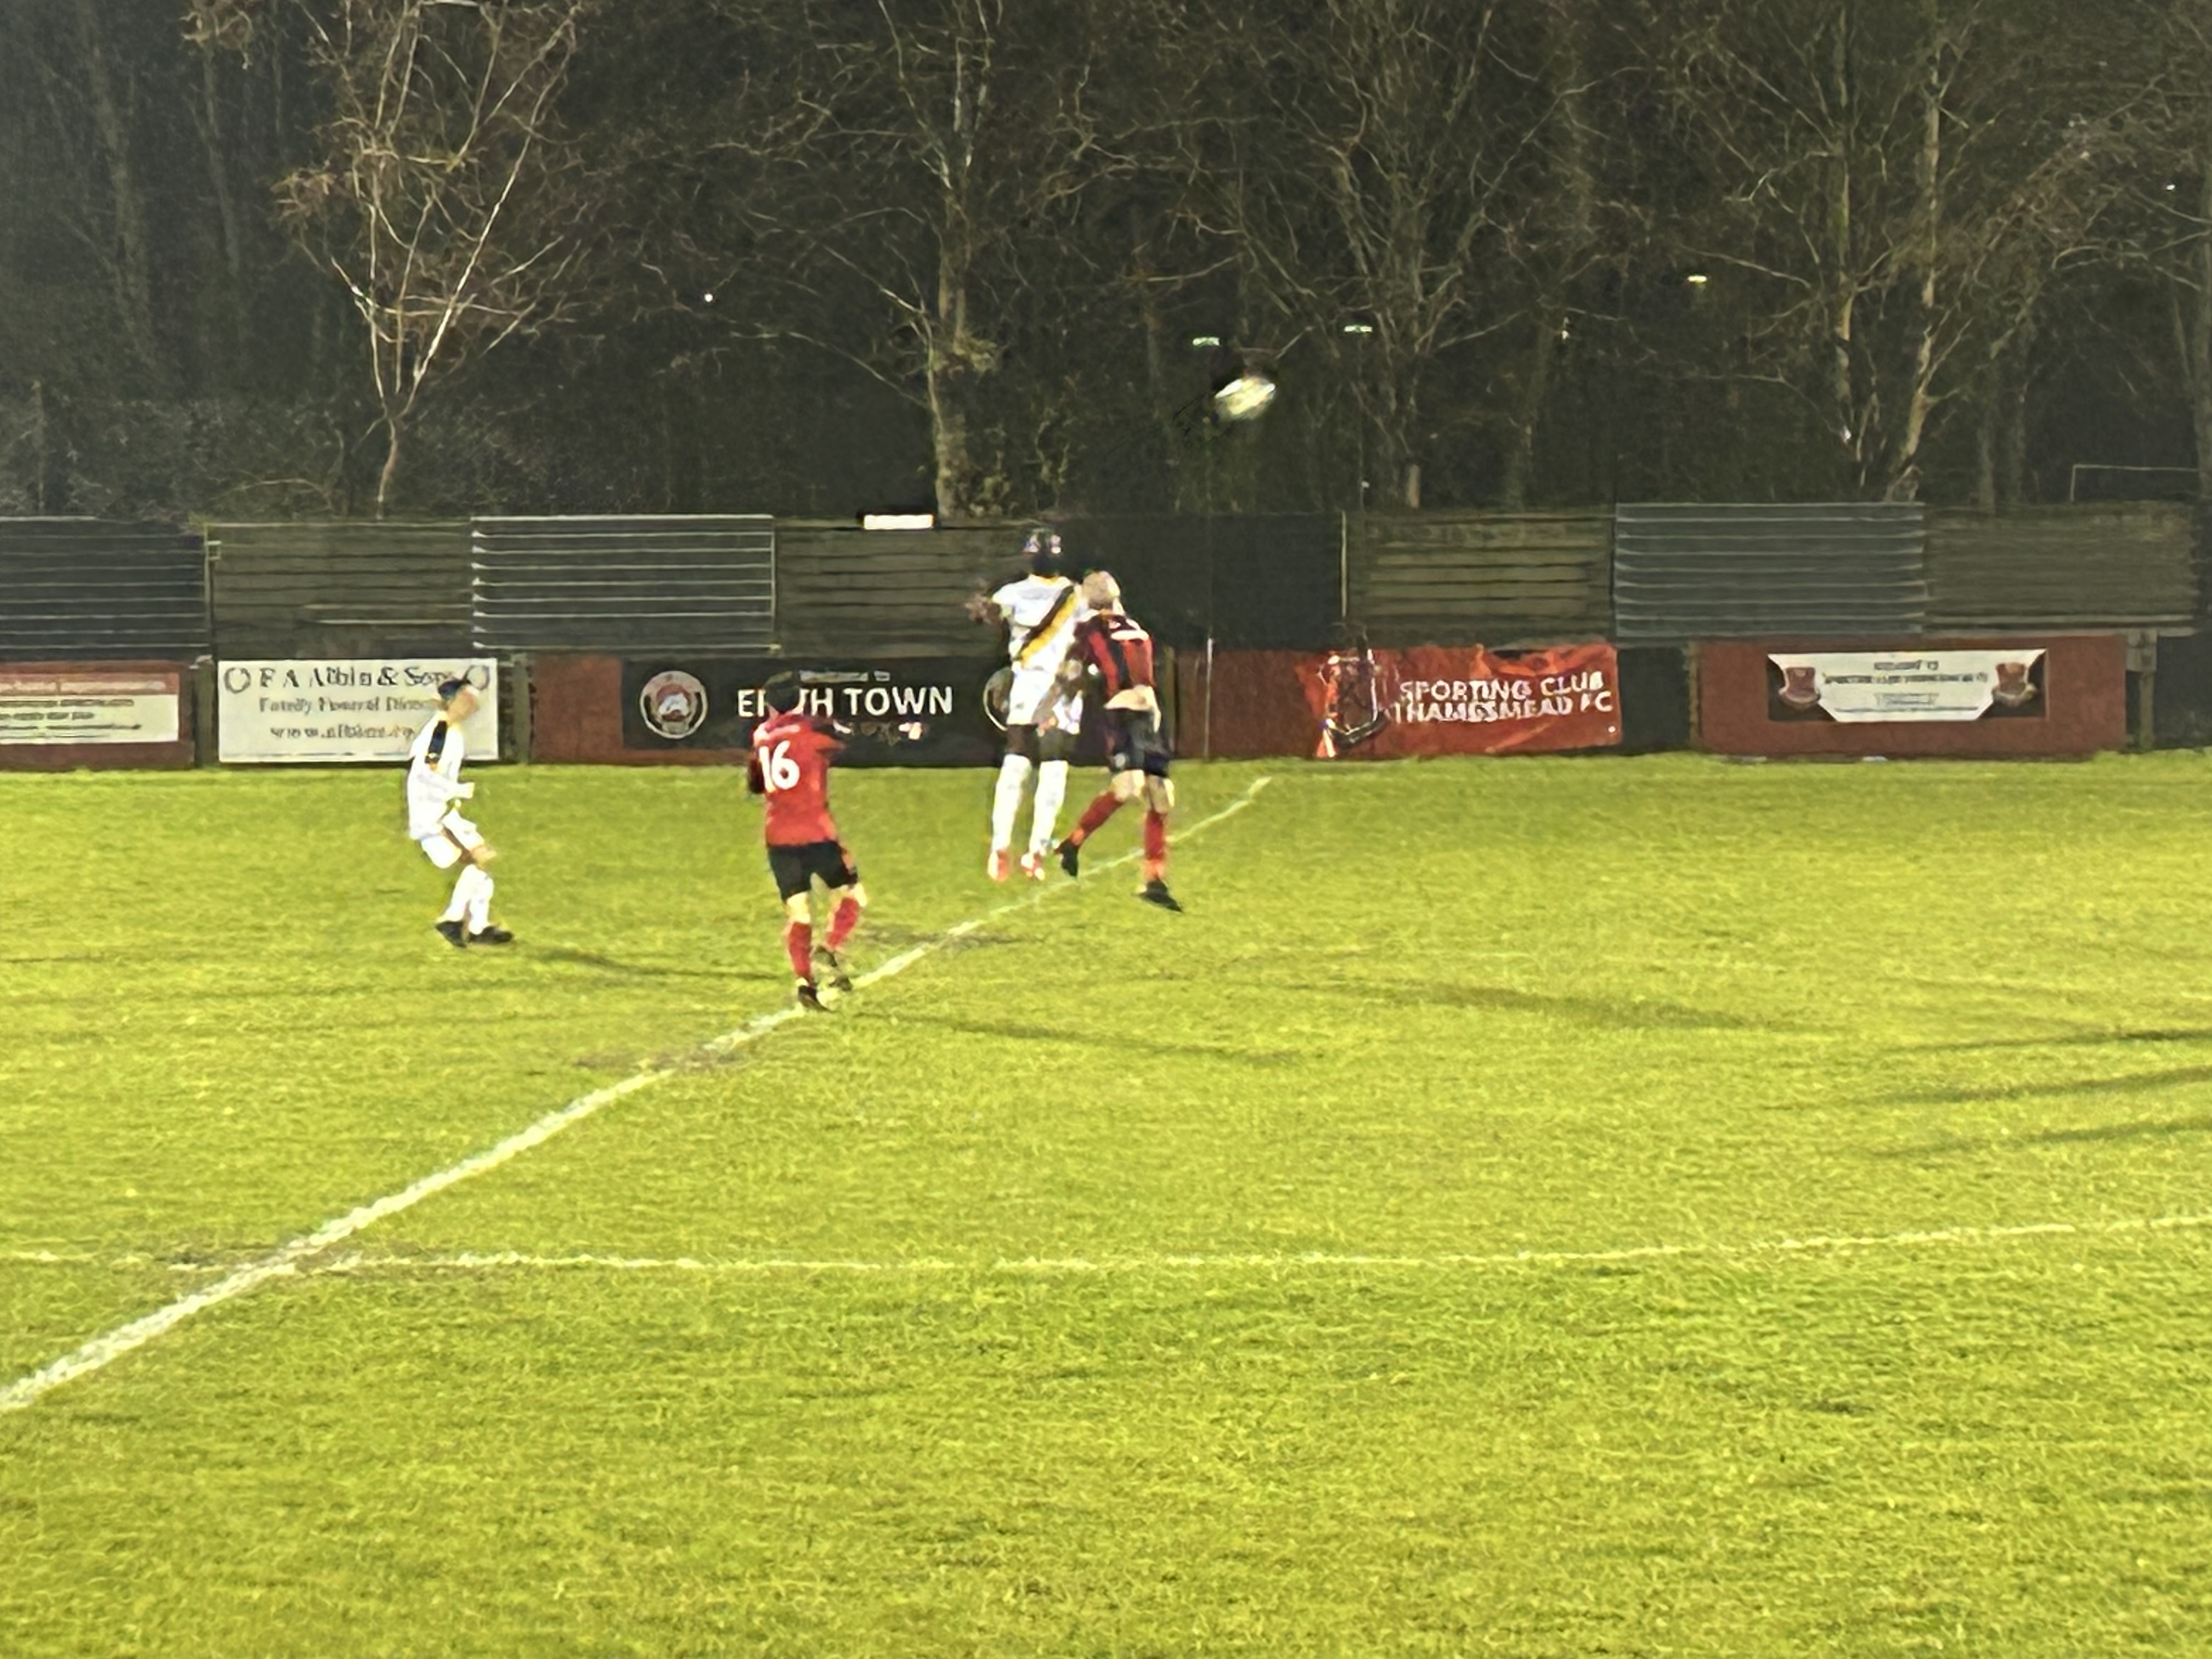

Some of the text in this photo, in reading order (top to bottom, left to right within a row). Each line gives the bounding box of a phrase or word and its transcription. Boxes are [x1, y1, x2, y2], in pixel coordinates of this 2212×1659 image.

[259, 668, 275, 687] F
[283, 669, 299, 687] A
[377, 667, 398, 687] &
[404, 666, 451, 687] Son
[1397, 670, 1605, 702] SPORTING CLUB
[843, 686, 953, 716] TOWN
[1393, 695, 1573, 724] THAMESMEAD
[758, 740, 800, 793] 16
